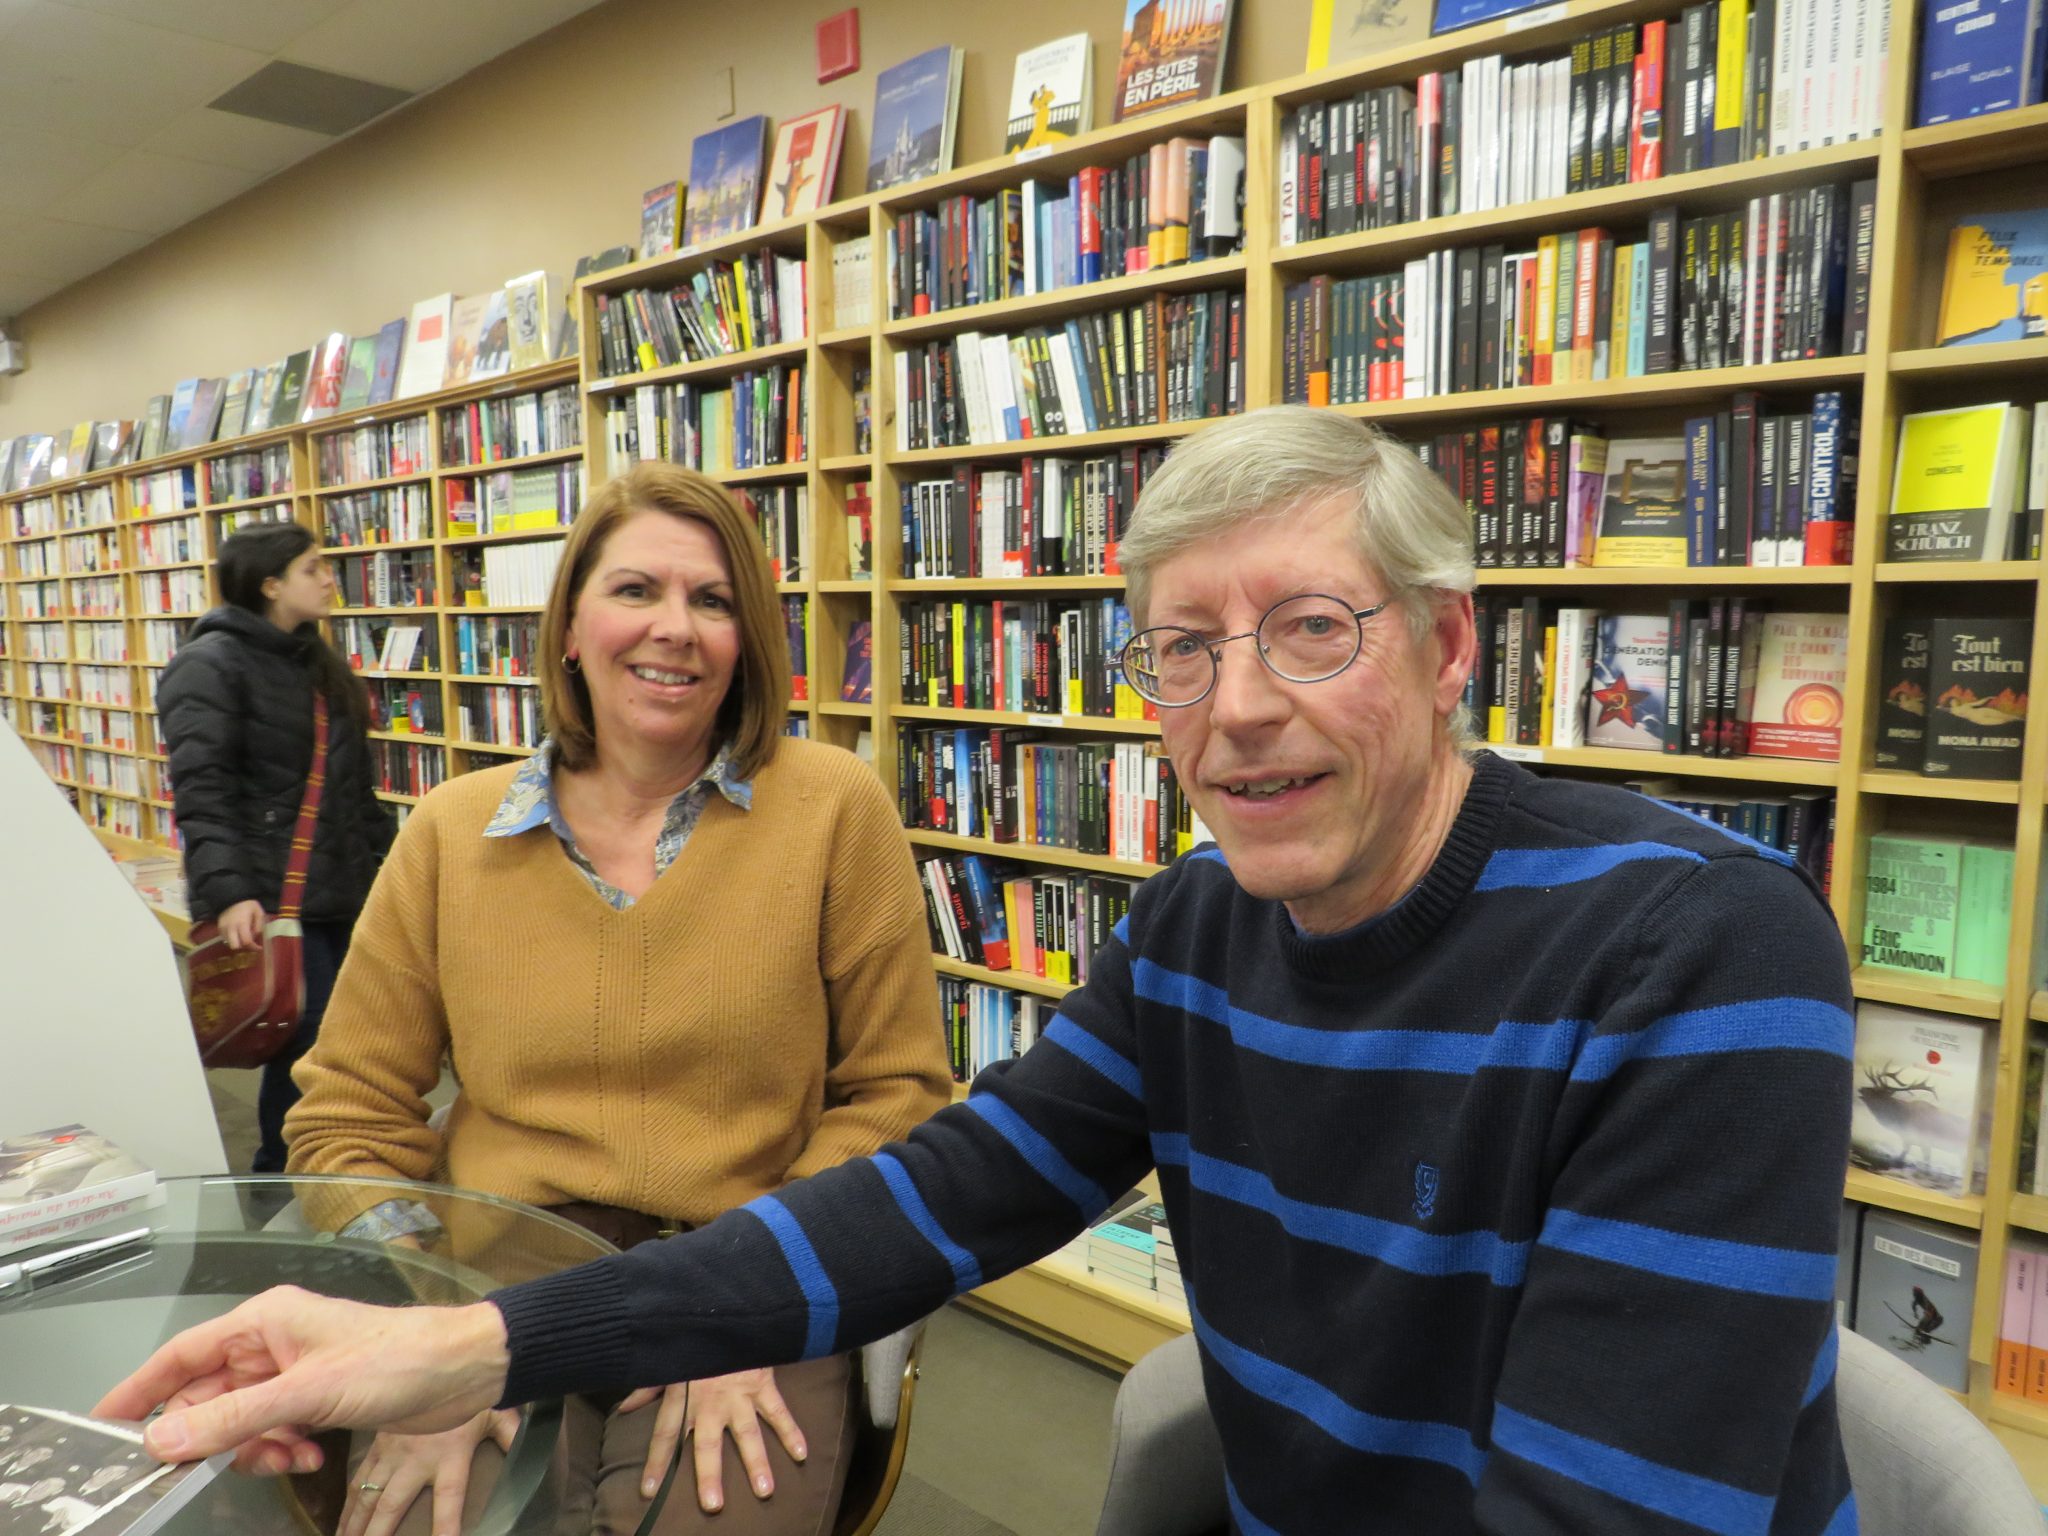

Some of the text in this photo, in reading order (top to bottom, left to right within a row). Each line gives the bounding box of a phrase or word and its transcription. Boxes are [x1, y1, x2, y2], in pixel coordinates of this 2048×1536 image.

[1128, 55, 1198, 89] LES SITES
[1930, 62, 2013, 83] BLAISE NDALA
[1124, 88, 1149, 107] EN
[1151, 73, 1201, 100] PÉRIL
[1283, 181, 1293, 220] TAO
[1856, 204, 1873, 275] JAMES ROLLINS
[1577, 242, 1593, 337] GIACOMETTI RAVENNE
[1652, 268, 1668, 337] NUIT AMÉRICAINE
[1289, 300, 1298, 339] CHAMBRE
[1147, 327, 1155, 371] STEPHEN
[1482, 460, 1495, 505] LE VIDE
[1762, 476, 1772, 486] LA
[1789, 475, 1800, 485] LA
[1908, 521, 1962, 537] FRANZ
[1952, 634, 2001, 654] Tout
[1902, 652, 1928, 669] est
[1952, 656, 2025, 673] est bien
[1706, 645, 1721, 708] LA PATHOLOGISTE
[1724, 646, 1740, 709] LA PATHOLOGISTE
[1668, 688, 1679, 708] AVANT
[1668, 708, 1679, 726] JUSTE
[1938, 736, 2021, 748] MONA AWAD
[1867, 876, 1897, 896] 1984
[1034, 892, 1042, 910] SALE
[1872, 926, 1901, 949] ÉRIC
[1862, 944, 1945, 973] PLAMONDON
